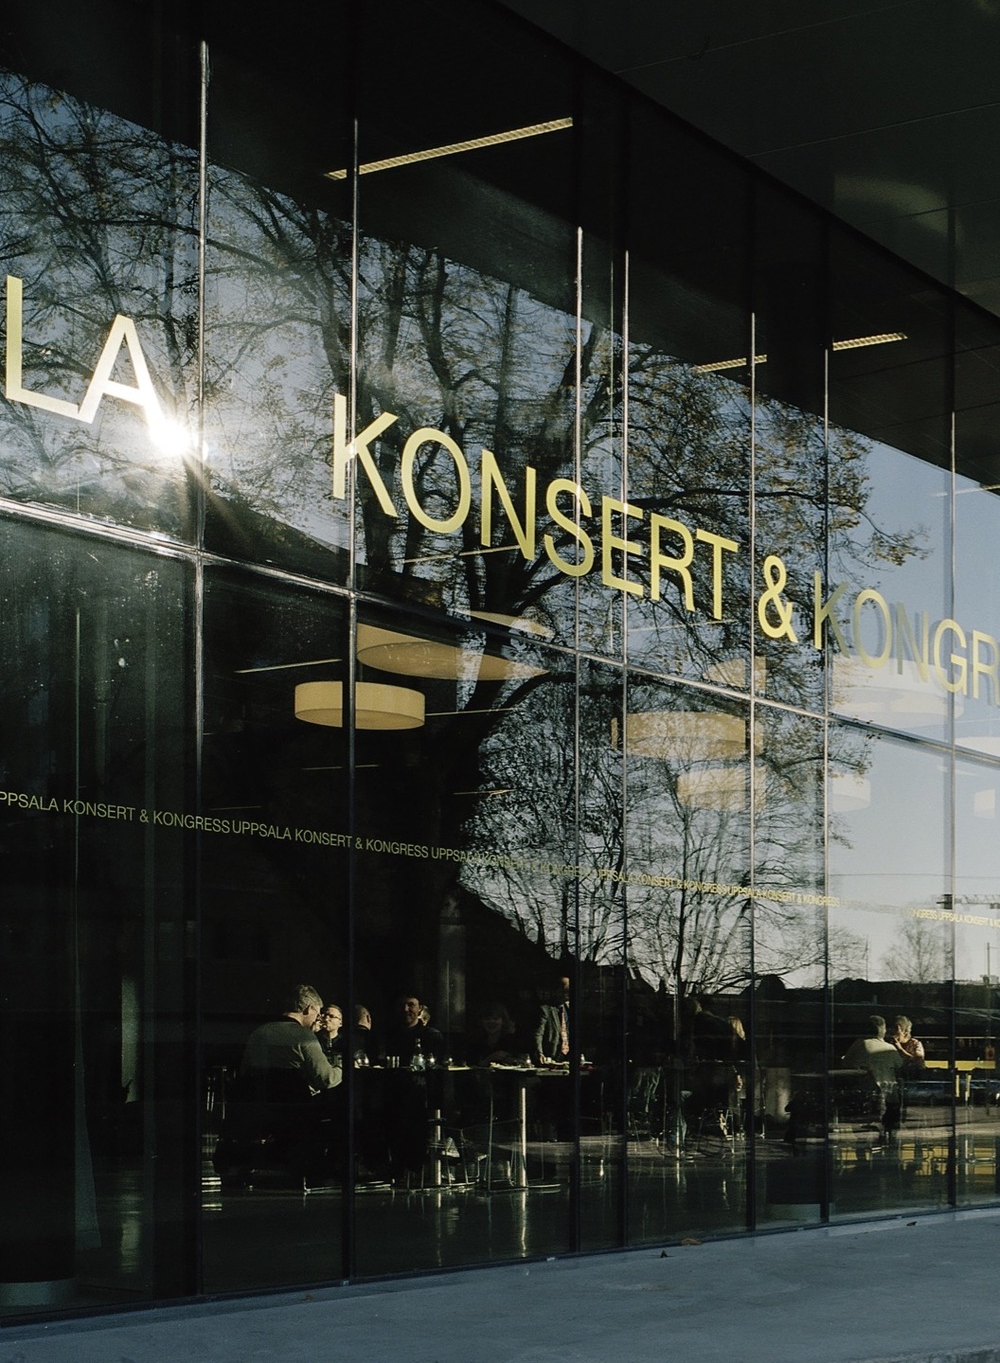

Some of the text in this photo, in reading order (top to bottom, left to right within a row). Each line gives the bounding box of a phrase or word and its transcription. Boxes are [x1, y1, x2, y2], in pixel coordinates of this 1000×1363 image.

[332, 393, 740, 621] KONSERT
[758, 555, 798, 644] &
[63, 799, 136, 821] KONSERT
[139, 809, 149, 823] &
[153, 810, 230, 834] KONGRESS
[232, 820, 291, 840] UPPSALA
[295, 828, 353, 848] KONSERT
[355, 837, 363, 850] &
[366, 839, 428, 858] KONGRESS
